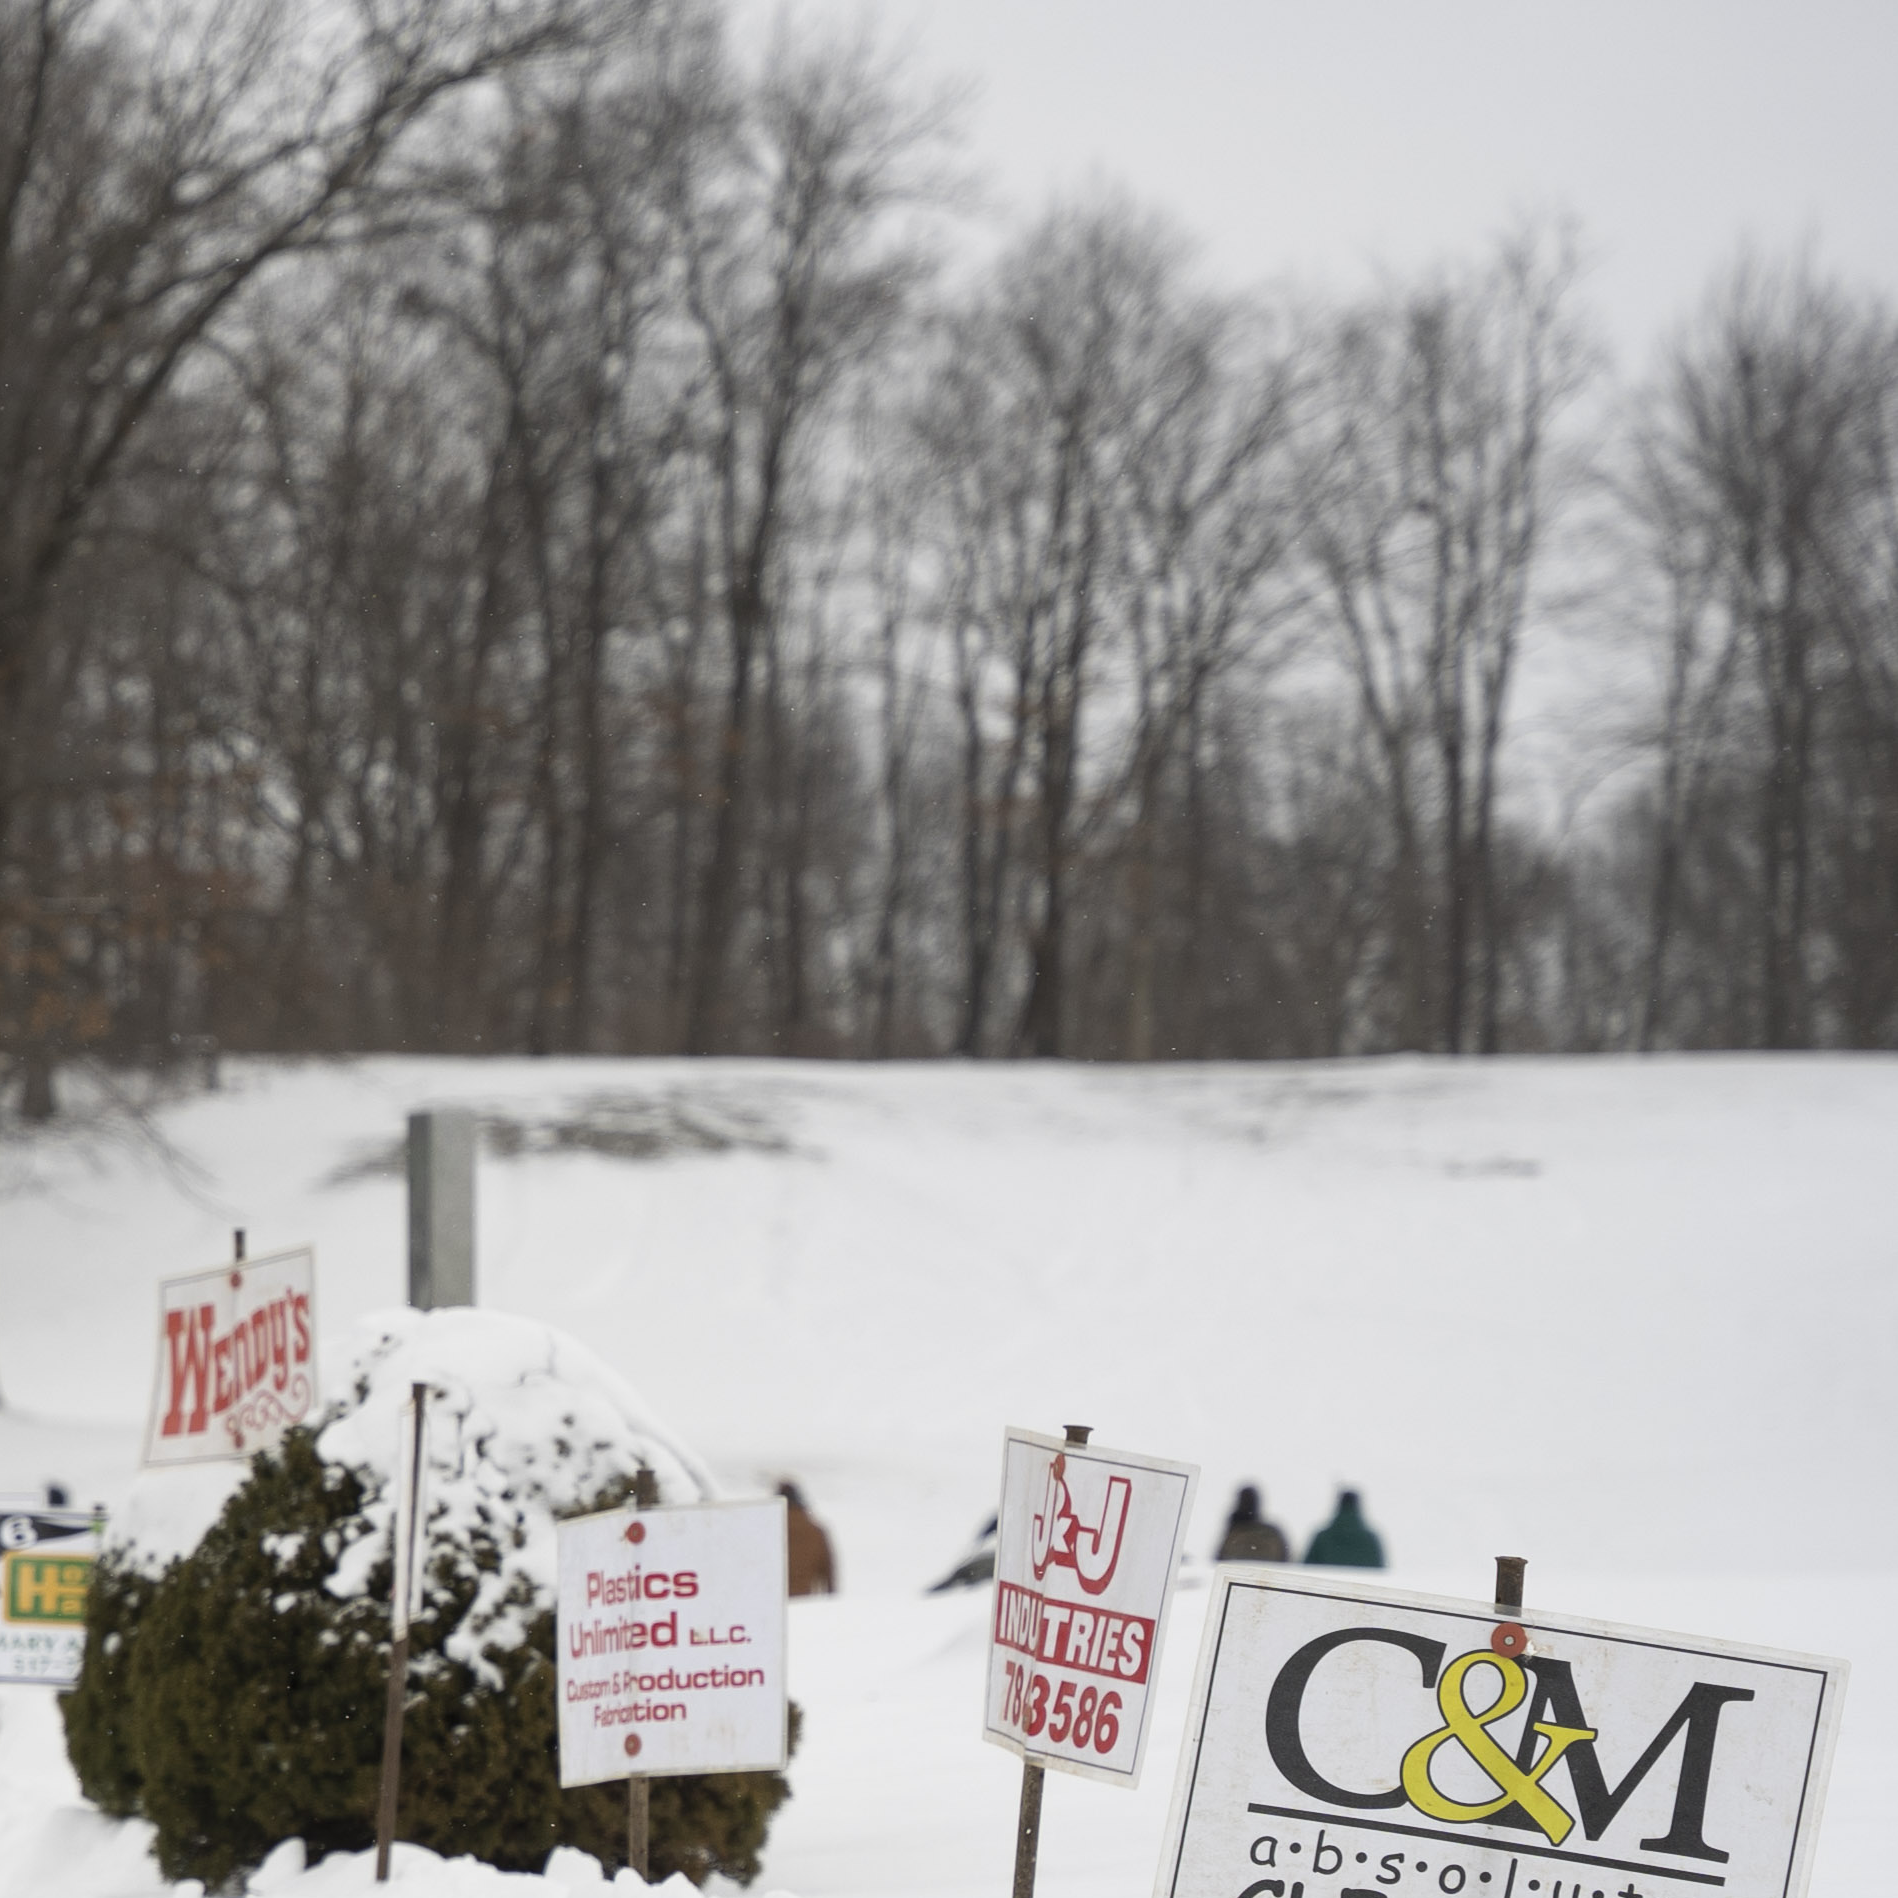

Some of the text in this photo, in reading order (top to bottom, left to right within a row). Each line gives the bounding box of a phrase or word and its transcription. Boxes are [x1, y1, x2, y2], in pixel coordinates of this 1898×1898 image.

[587, 1563, 699, 1607] Plastics
[570, 1611, 677, 1659] Unlimited
[623, 1664, 764, 1693] Production
[594, 1699, 686, 1728] Fabrication
[1265, 1626, 1756, 1864] C&M
